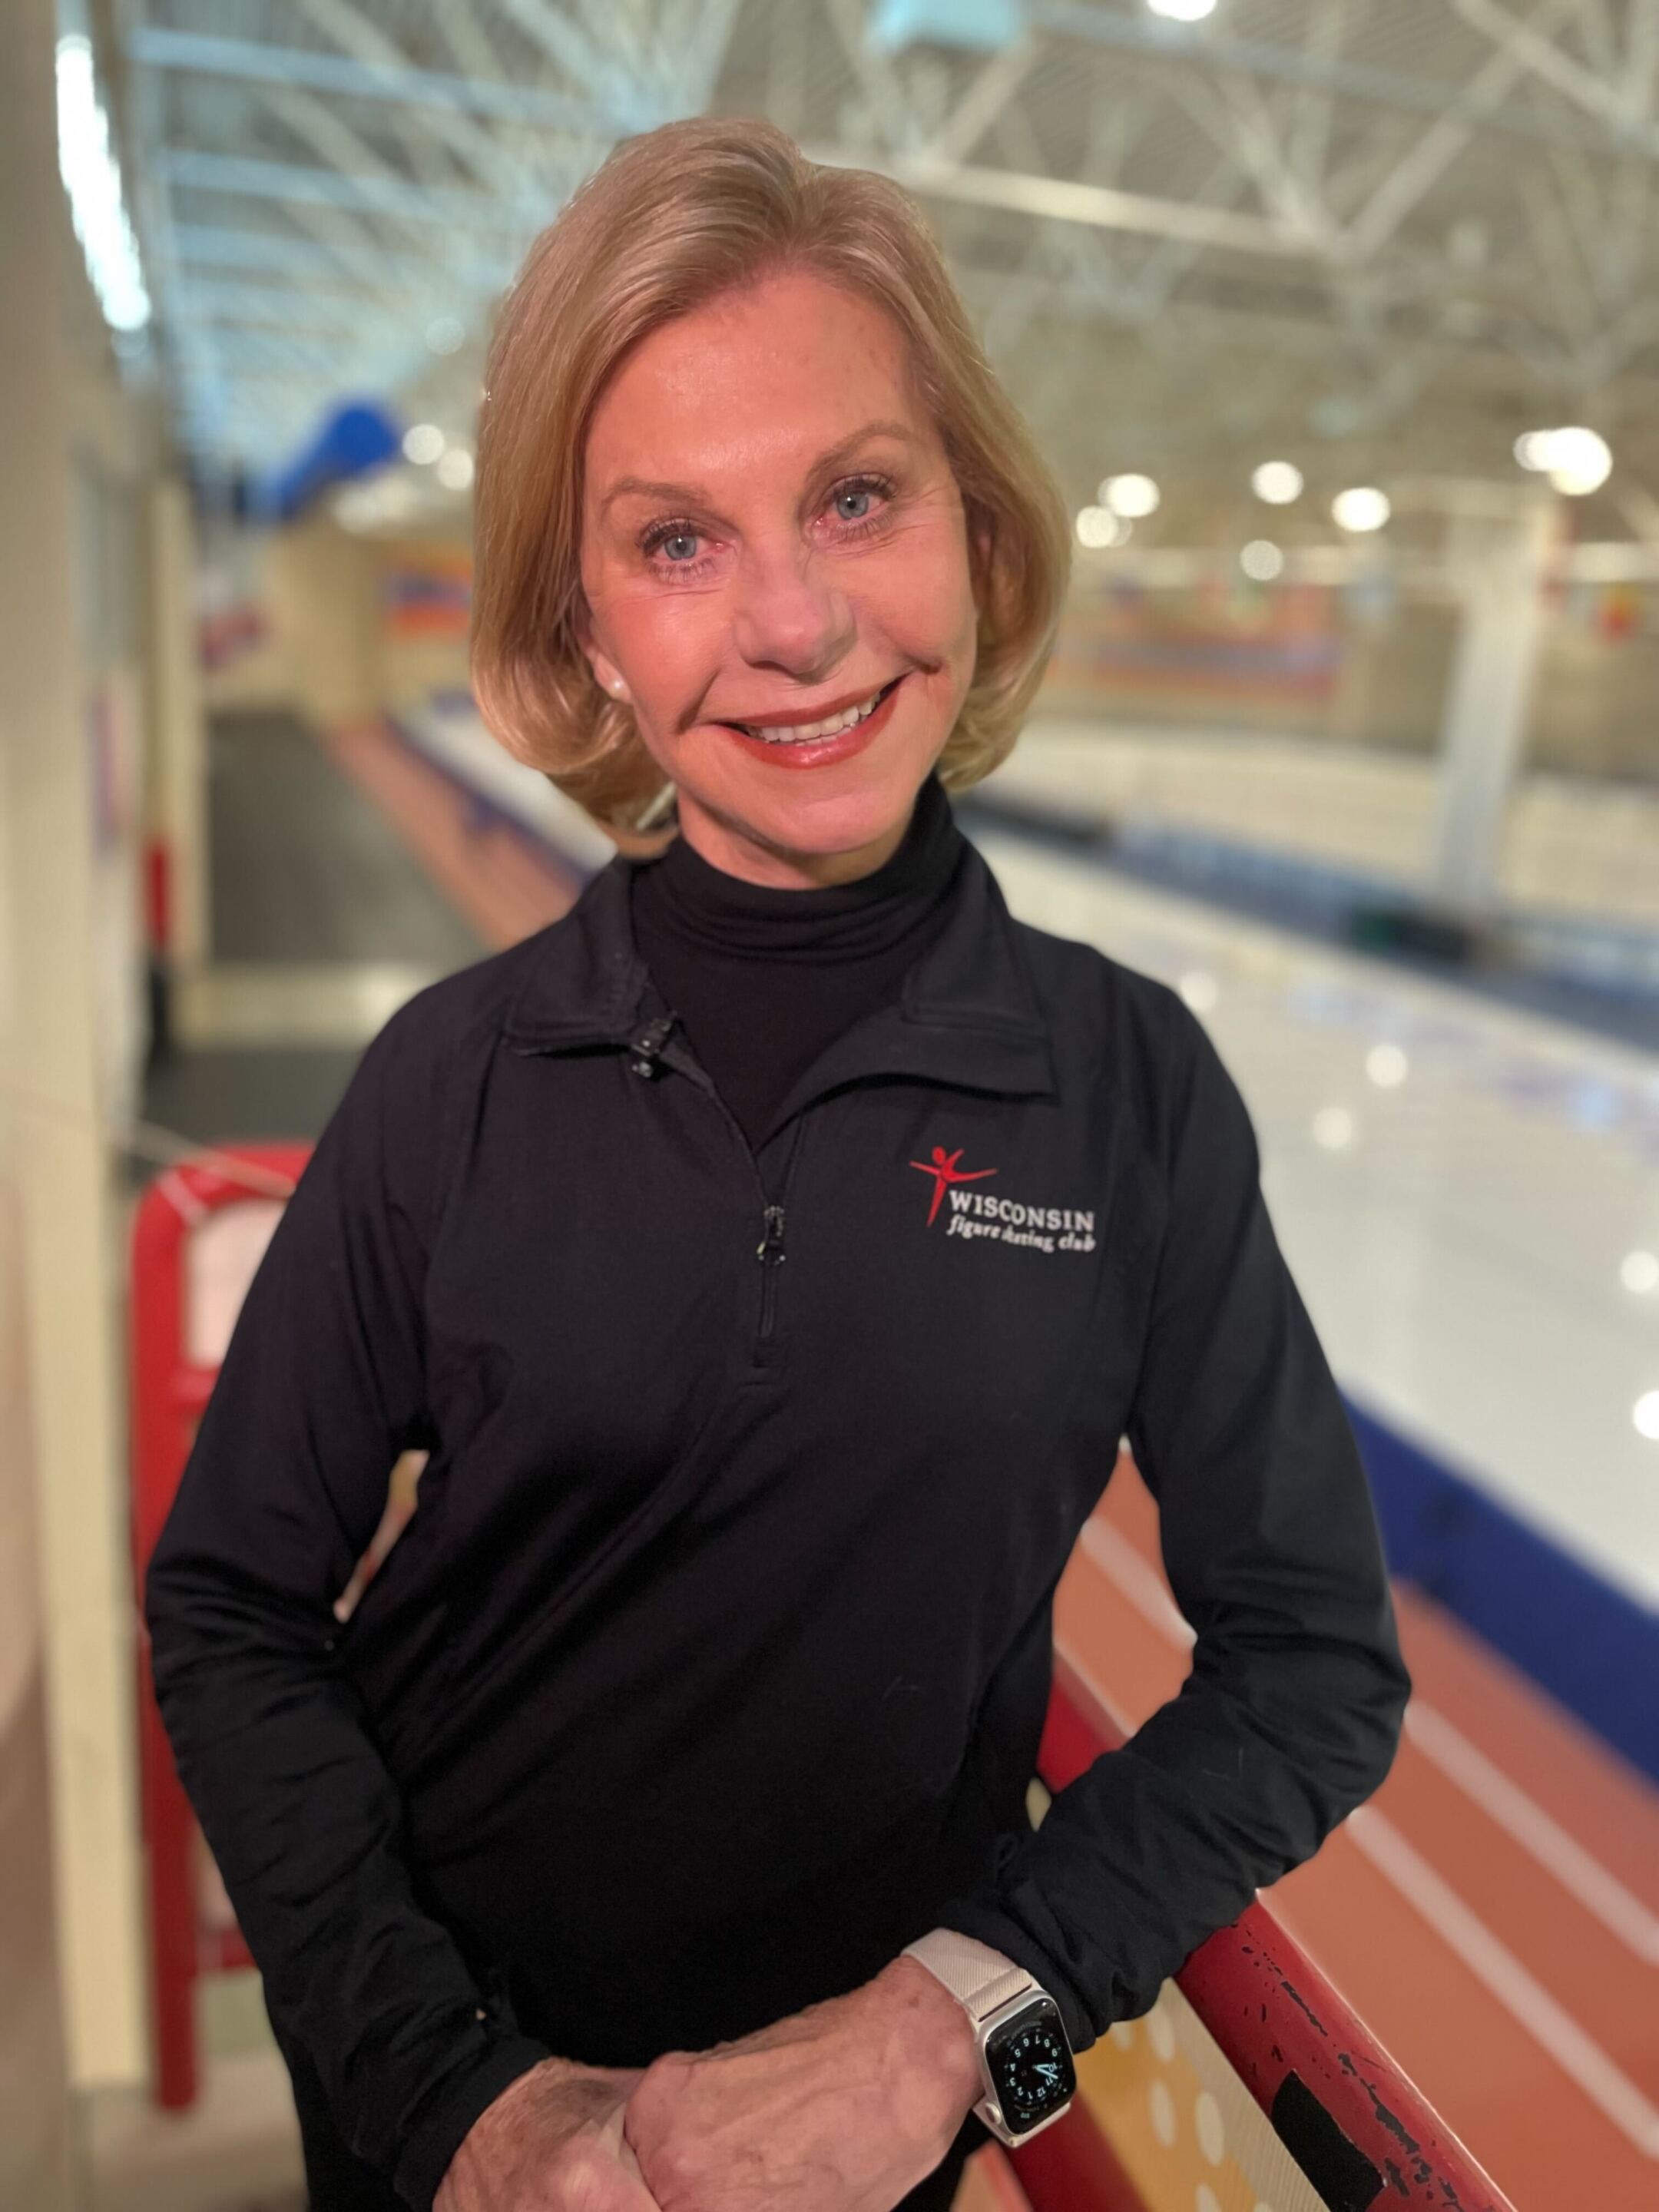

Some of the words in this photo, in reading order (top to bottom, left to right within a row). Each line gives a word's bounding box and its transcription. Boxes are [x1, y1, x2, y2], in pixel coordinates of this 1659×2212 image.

[949, 1190, 1094, 1233] WISCONSIN
[946, 1214, 1001, 1239] figure
[1058, 1231, 1096, 1252] club
